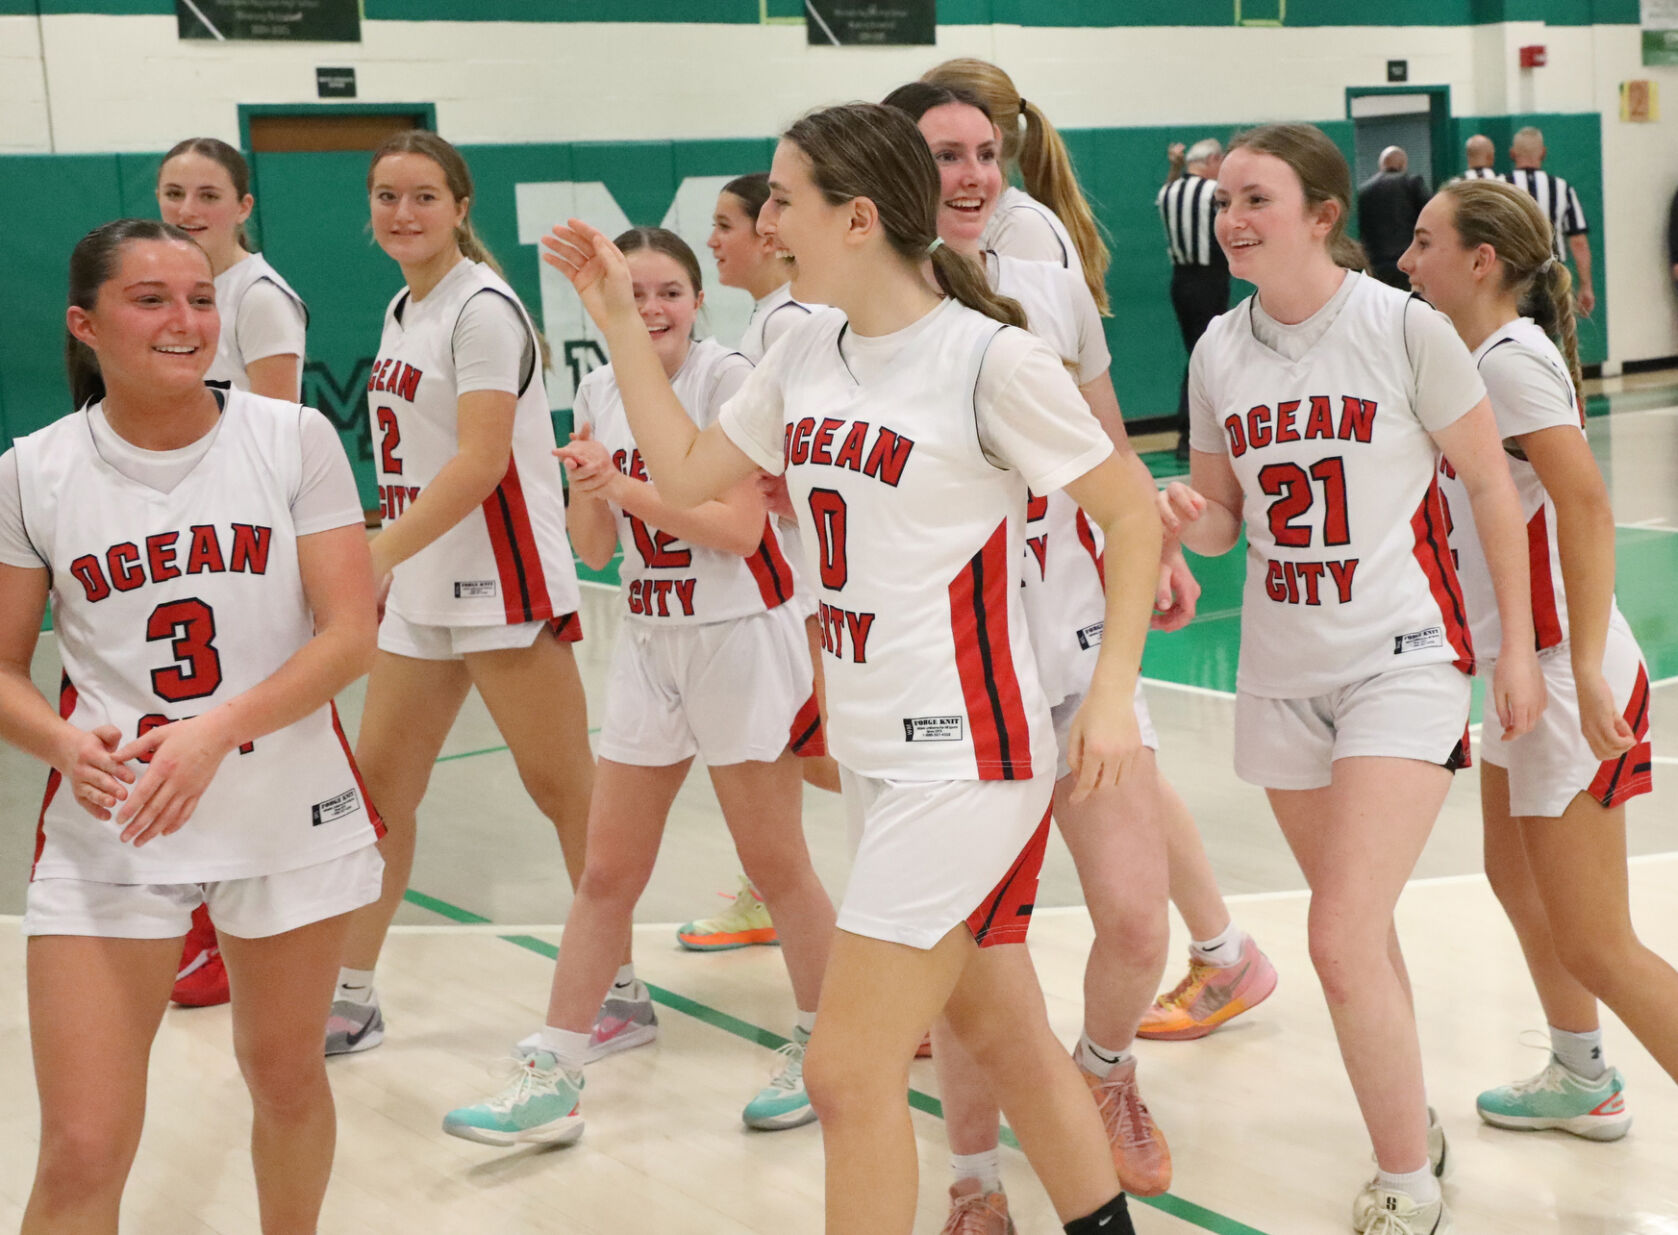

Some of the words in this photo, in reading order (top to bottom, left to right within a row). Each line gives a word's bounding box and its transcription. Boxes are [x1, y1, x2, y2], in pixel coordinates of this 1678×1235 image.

[367, 358, 424, 403] CEAN
[376, 405, 403, 475] 2
[1224, 395, 1378, 459] OCEAN
[1257, 455, 1351, 548] 21
[70, 523, 272, 603] OCEAN
[807, 487, 848, 592] 0
[628, 578, 697, 617] CITY
[1265, 558, 1360, 605] CITY
[146, 597, 223, 703] 3
